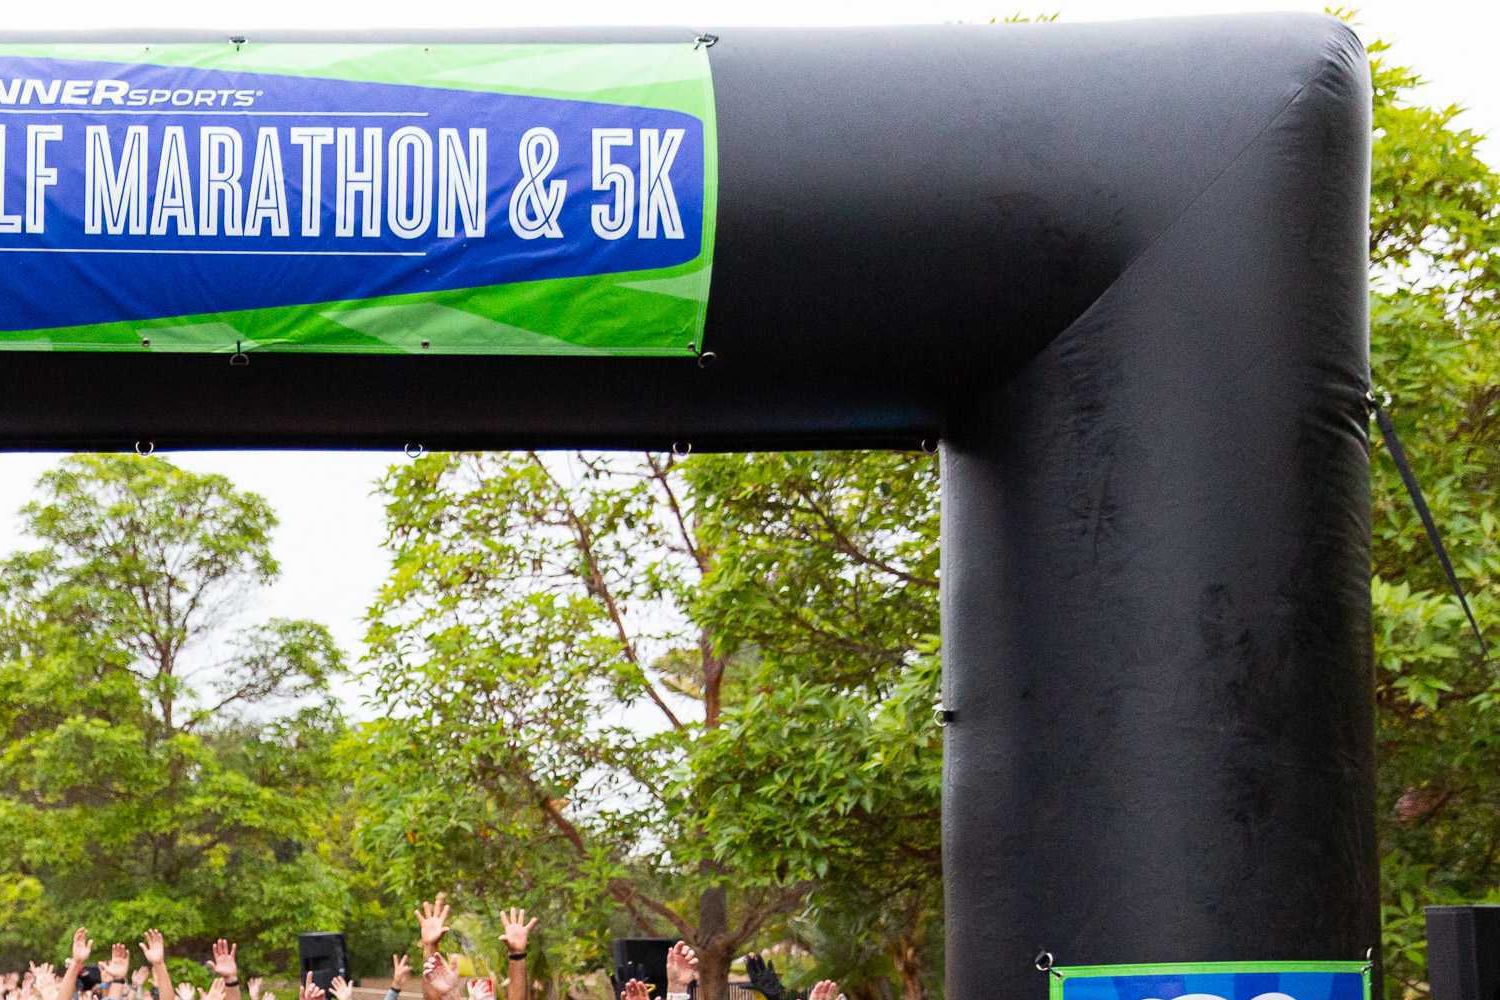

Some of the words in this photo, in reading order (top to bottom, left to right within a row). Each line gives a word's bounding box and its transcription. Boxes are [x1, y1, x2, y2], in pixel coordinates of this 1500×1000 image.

[84, 125, 488, 239] MARATHON
[508, 126, 568, 240] &
[590, 128, 686, 240] 5K
